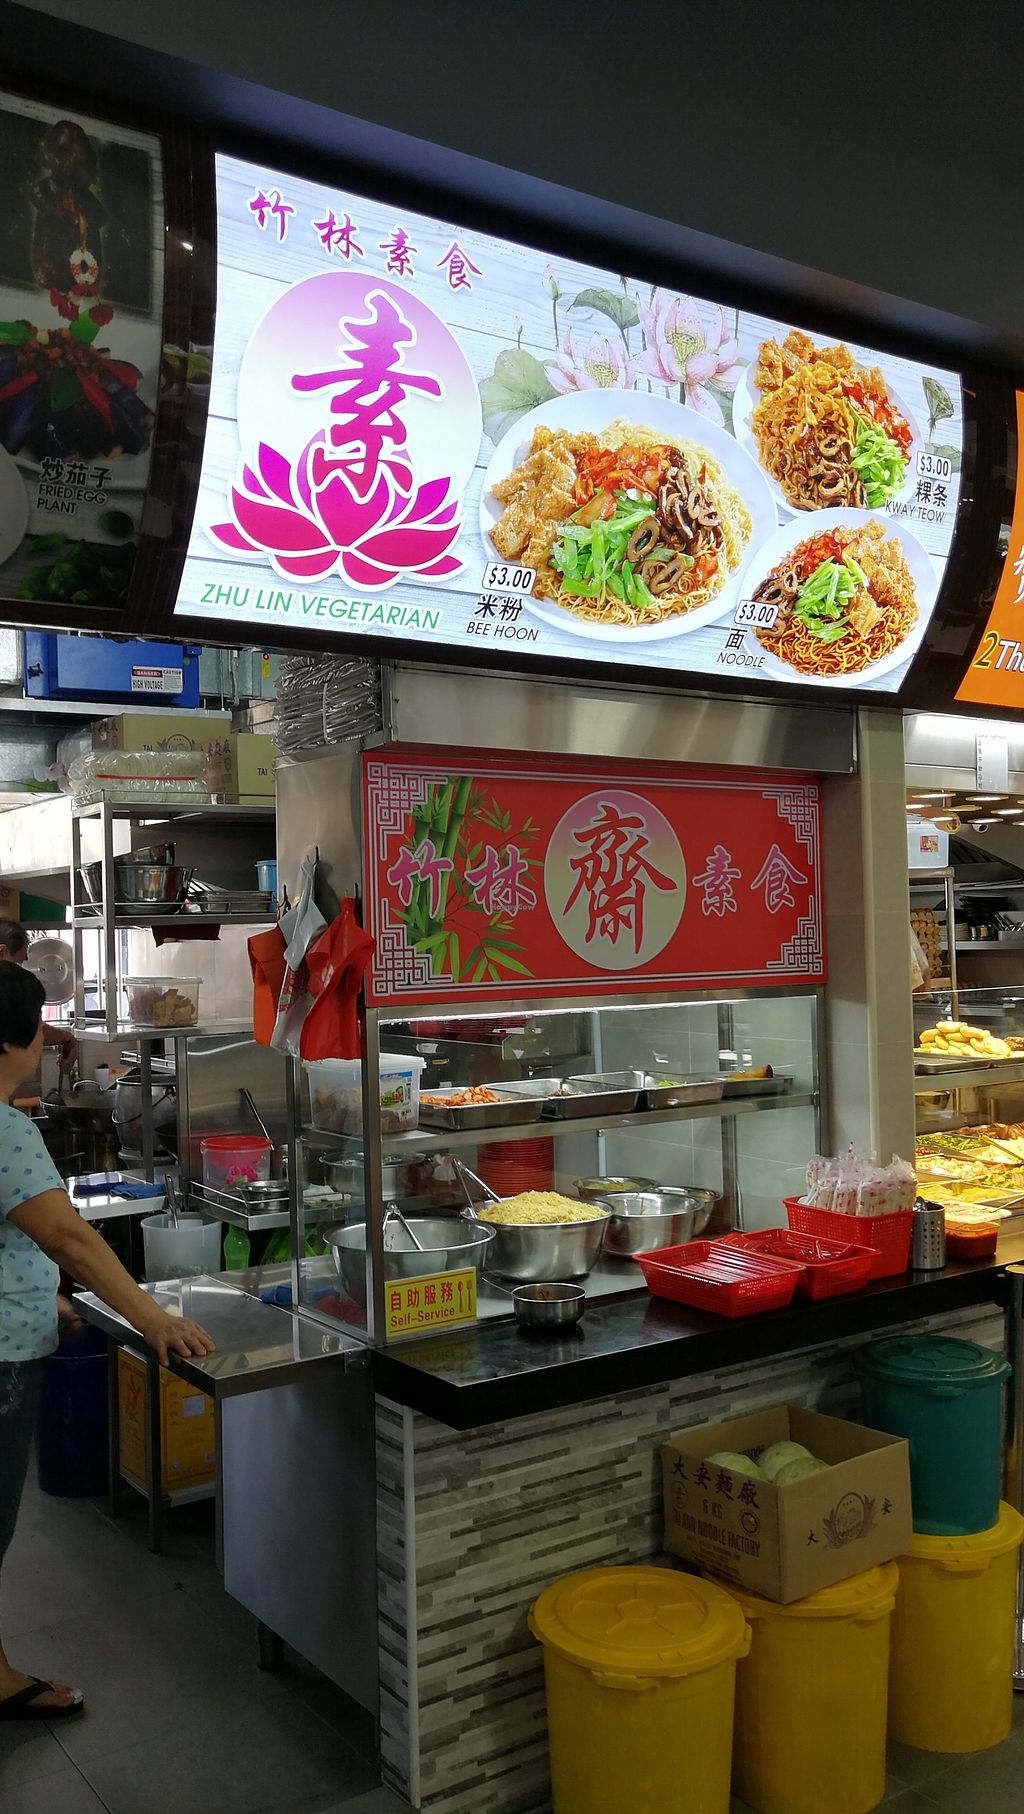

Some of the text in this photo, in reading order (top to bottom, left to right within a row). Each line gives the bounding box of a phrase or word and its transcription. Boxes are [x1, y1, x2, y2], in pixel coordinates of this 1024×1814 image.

[249, 190, 483, 289] 竹林素食
[292, 292, 442, 496] 素
[40, 457, 112, 489] 炒茄子
[920, 454, 949, 477] $3.00
[39, 483, 106, 504] FRIED EGG
[915, 480, 948, 507] 粿条
[37, 498, 77, 514] PLANT
[885, 500, 945, 523] KWAY TEOW
[488, 565, 532, 589] $3.00
[200, 583, 440, 630] ZHU LIN VEGETARIAN
[474, 594, 523, 621] 米粉
[739, 602, 775, 623] $3.00
[466, 621, 539, 642] BEE HOON
[724, 627, 748, 650] 面
[716, 652, 766, 668] NOODLE
[144, 680, 163, 690] VOLTAGE
[387, 842, 537, 918] 竹林
[693, 844, 807, 914] 素食
[390, 1281, 453, 1312] 自助服務
[391, 1306, 455, 1328] Self-Service
[727, 1530, 761, 1559] FACTORY
